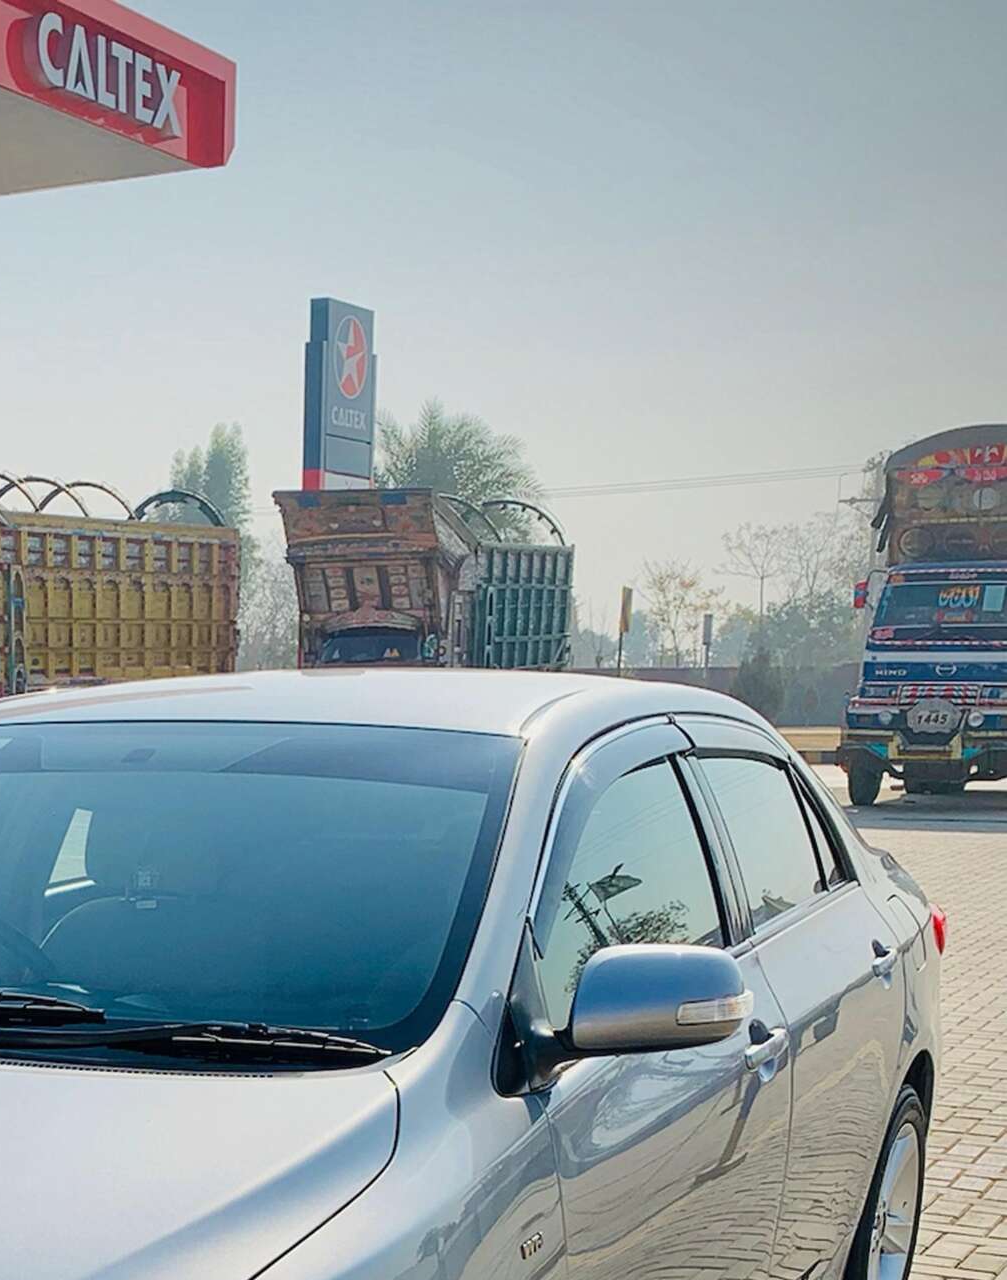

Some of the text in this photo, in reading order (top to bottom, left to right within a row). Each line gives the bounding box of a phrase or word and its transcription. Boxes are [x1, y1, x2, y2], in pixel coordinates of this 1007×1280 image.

[38, 11, 181, 138] CALTEX
[330, 405, 367, 431] CALTEX
[917, 713, 949, 725] 1445
